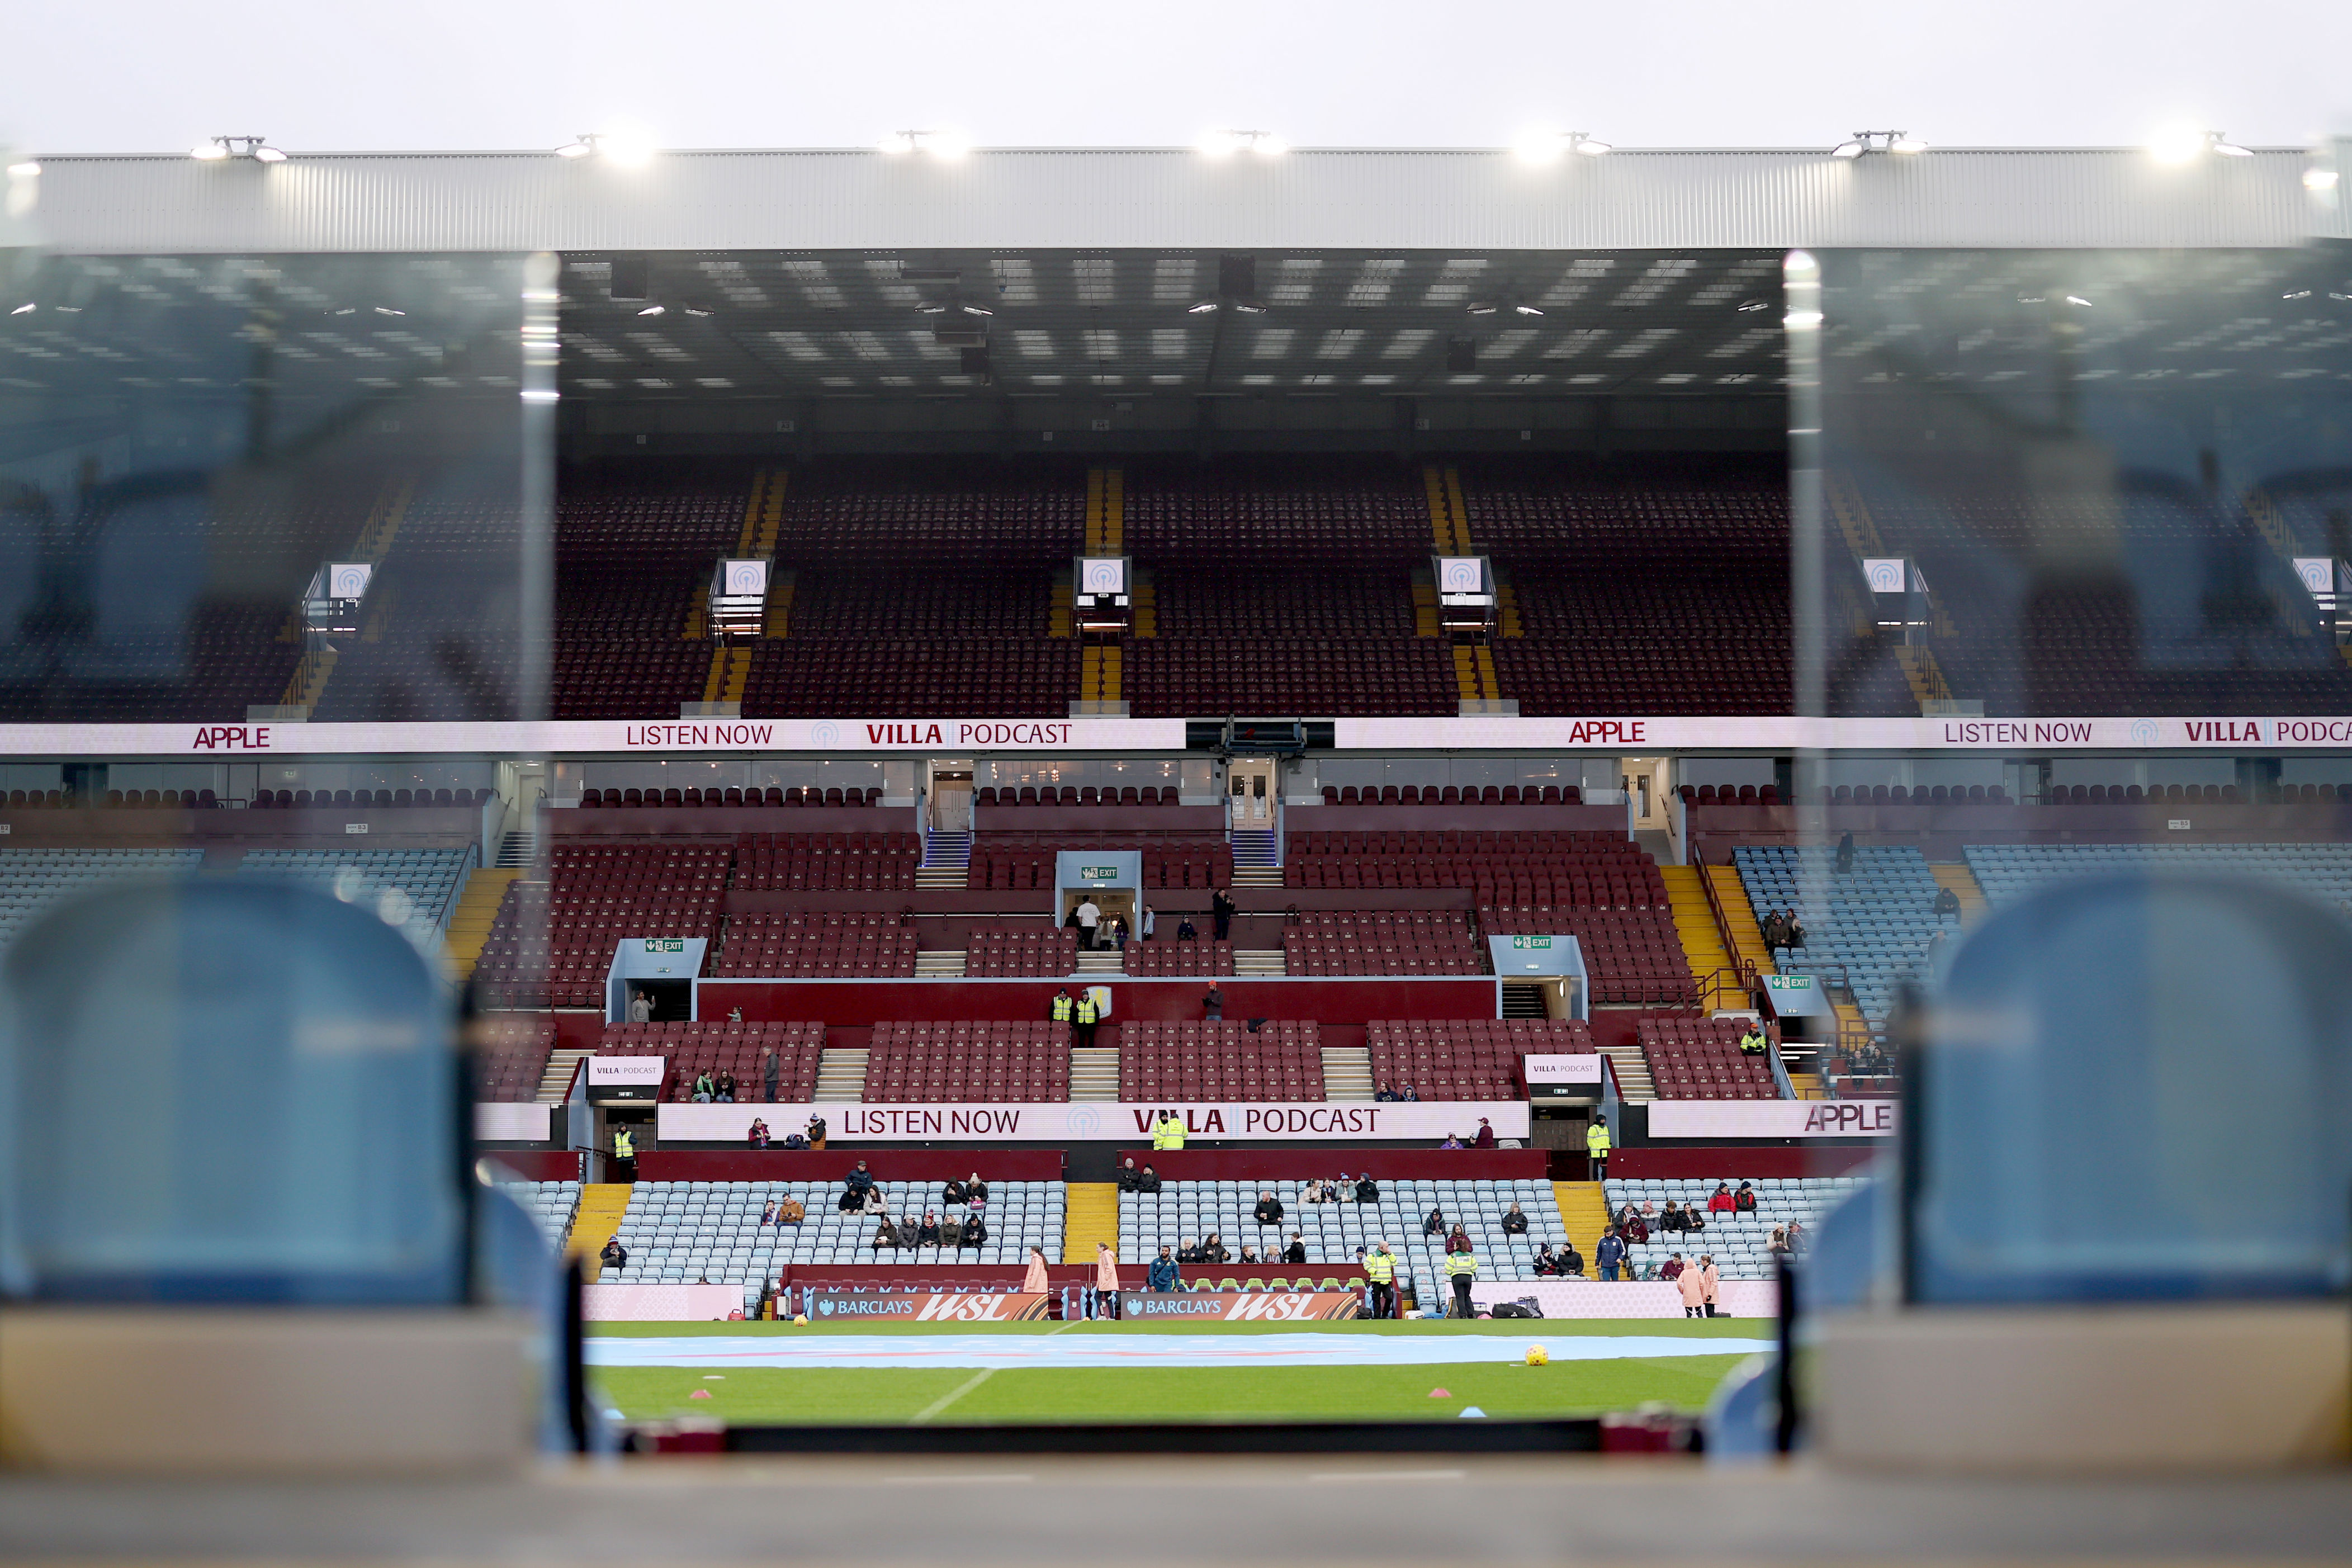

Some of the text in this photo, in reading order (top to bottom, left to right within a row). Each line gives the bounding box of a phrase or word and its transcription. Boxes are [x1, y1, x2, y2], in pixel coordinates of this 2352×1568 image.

[193, 728, 269, 749] APPLE
[627, 724, 1072, 745] LISTEN NOW VILLA PODCAST
[1569, 722, 1645, 743] APPLE
[1946, 724, 2027, 742] LISTEN
[2036, 723, 2092, 742] NOW
[2185, 722, 2260, 741] VILLA
[845, 1110, 941, 1134] LISTEN
[952, 1110, 1020, 1134] NOW
[1246, 1109, 1380, 1133] PODCAST
[1805, 1105, 1891, 1131] APPLE
[837, 1294, 1009, 1321] BARCLAYS WSL
[1146, 1294, 1318, 1320] BARCLAYS WSL
